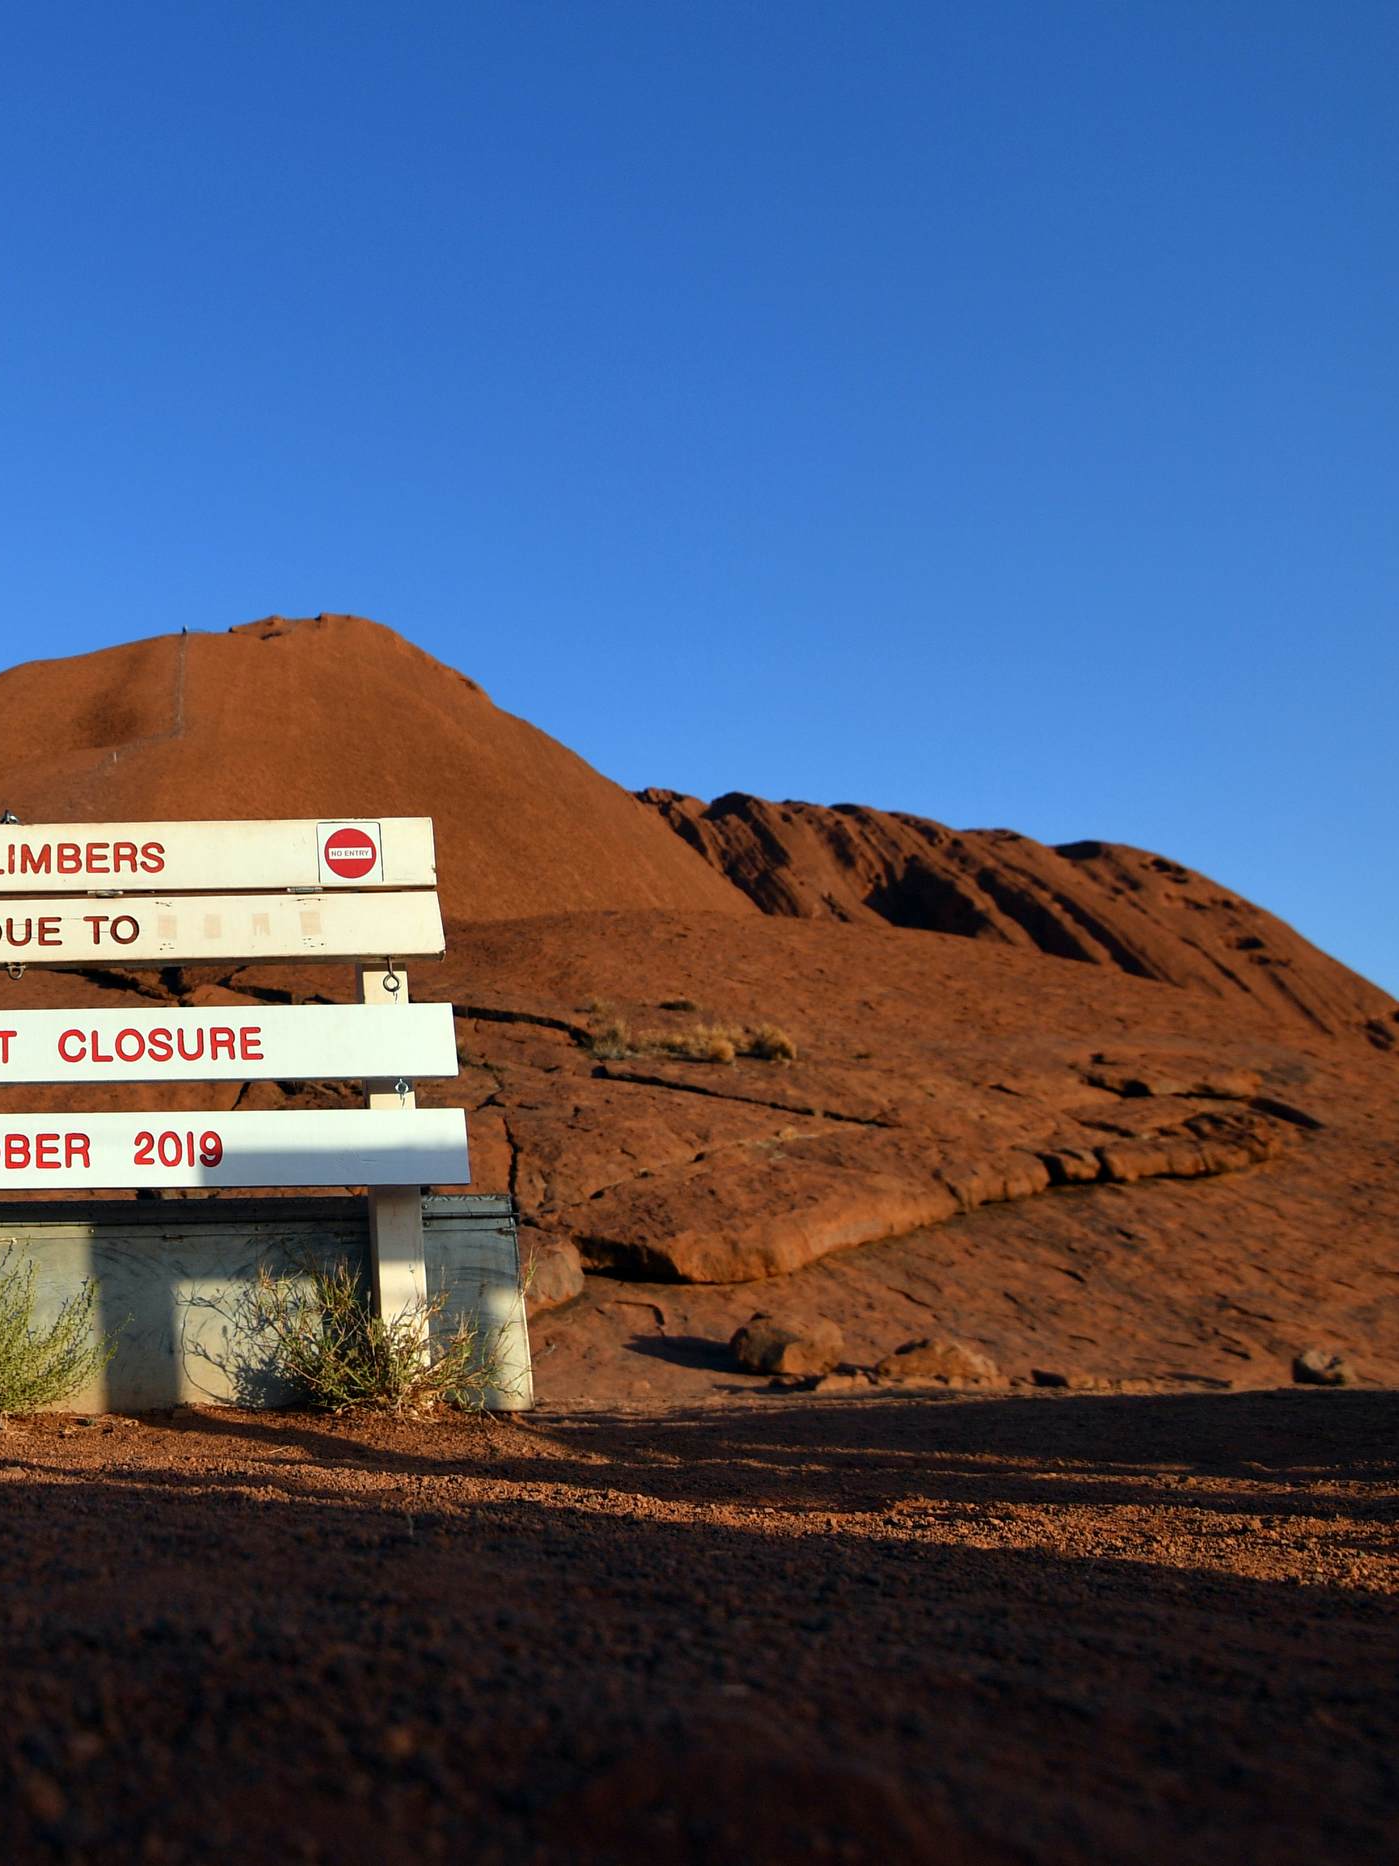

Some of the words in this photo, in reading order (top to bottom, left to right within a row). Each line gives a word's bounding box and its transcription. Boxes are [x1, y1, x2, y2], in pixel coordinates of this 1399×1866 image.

[83, 915, 140, 945] TO
[57, 1026, 264, 1064] CLOSURE
[133, 1130, 224, 1168] 2019
